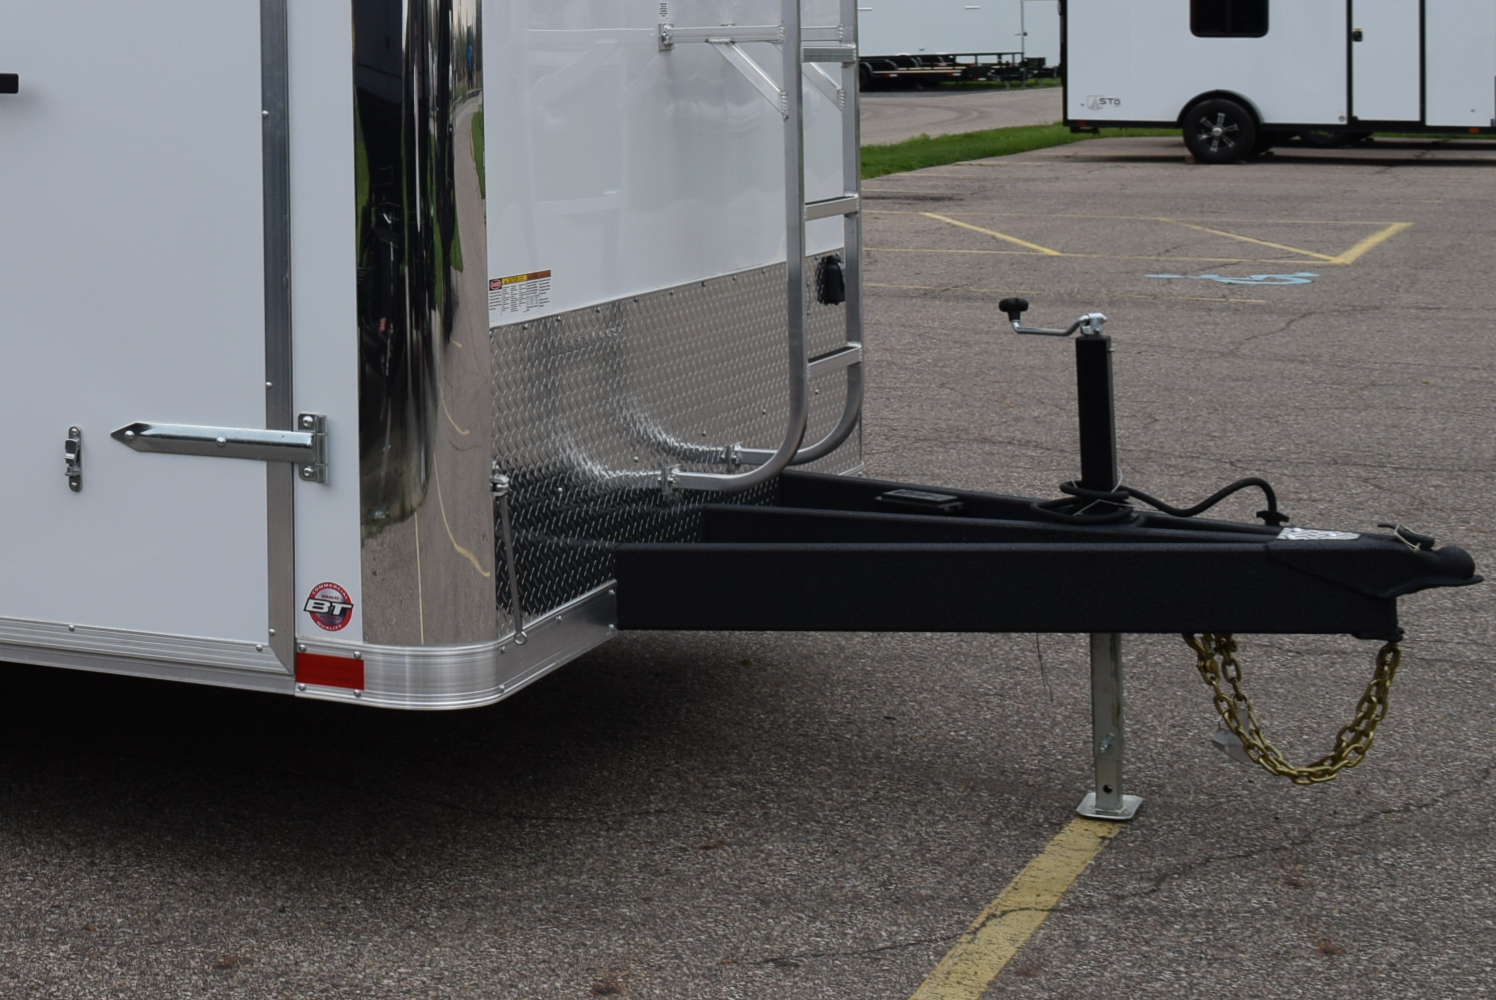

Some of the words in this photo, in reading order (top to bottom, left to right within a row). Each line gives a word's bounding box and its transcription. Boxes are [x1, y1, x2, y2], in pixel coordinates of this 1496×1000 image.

[312, 583, 348, 599] COMMERCIAL
[303, 598, 354, 616] BT
[316, 620, 342, 630] QUALITY
